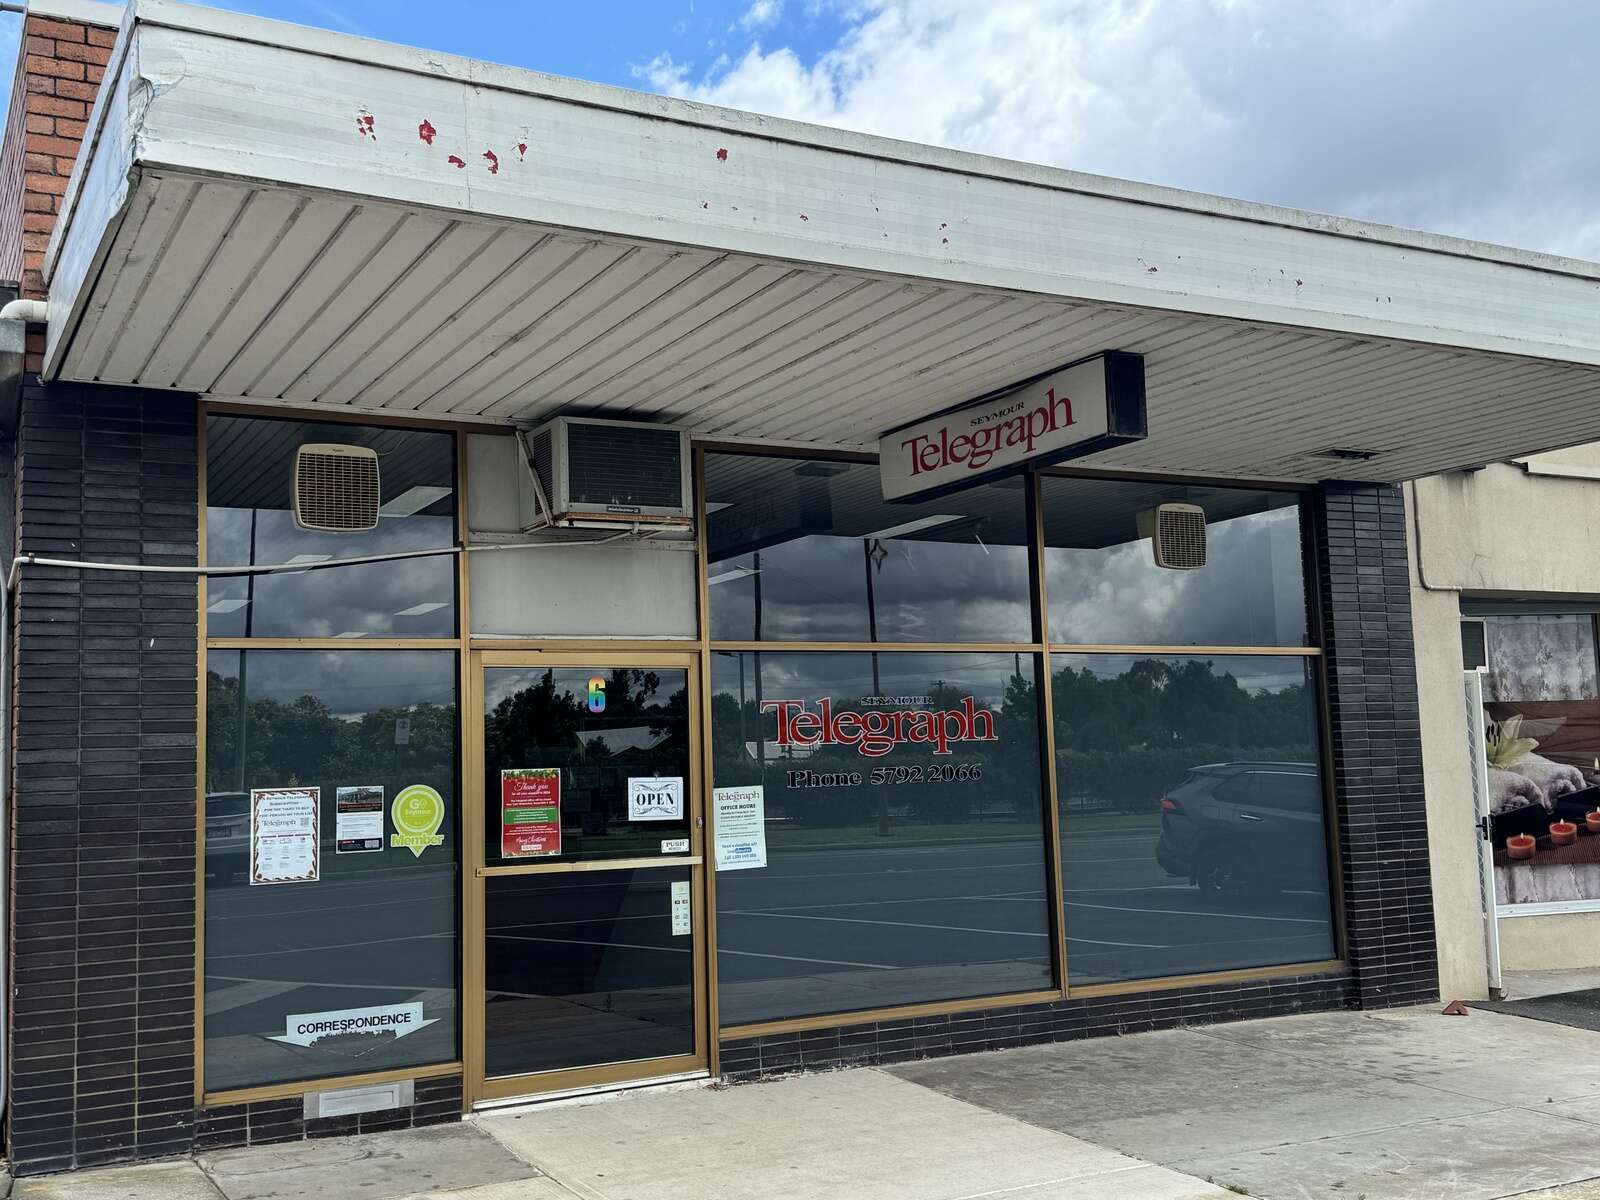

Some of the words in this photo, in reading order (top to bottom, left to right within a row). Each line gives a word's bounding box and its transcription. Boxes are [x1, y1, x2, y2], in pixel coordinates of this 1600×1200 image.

[970, 401, 1025, 427] SEYMOUR
[901, 387, 1078, 477] Telegraph
[588, 676, 606, 713] 6
[860, 696, 935, 706] SEYMOUR
[760, 696, 999, 757] Telegraph
[787, 770, 862, 788] Phone
[870, 765, 924, 785] 5792
[928, 763, 982, 782] 2066
[513, 782, 537, 791] Thank
[537, 784, 549, 793] you
[714, 790, 760, 802] Telegraph
[636, 793, 675, 806] OPEN
[392, 833, 443, 846] Member
[297, 1012, 412, 1035] CORRESPONDENCE
